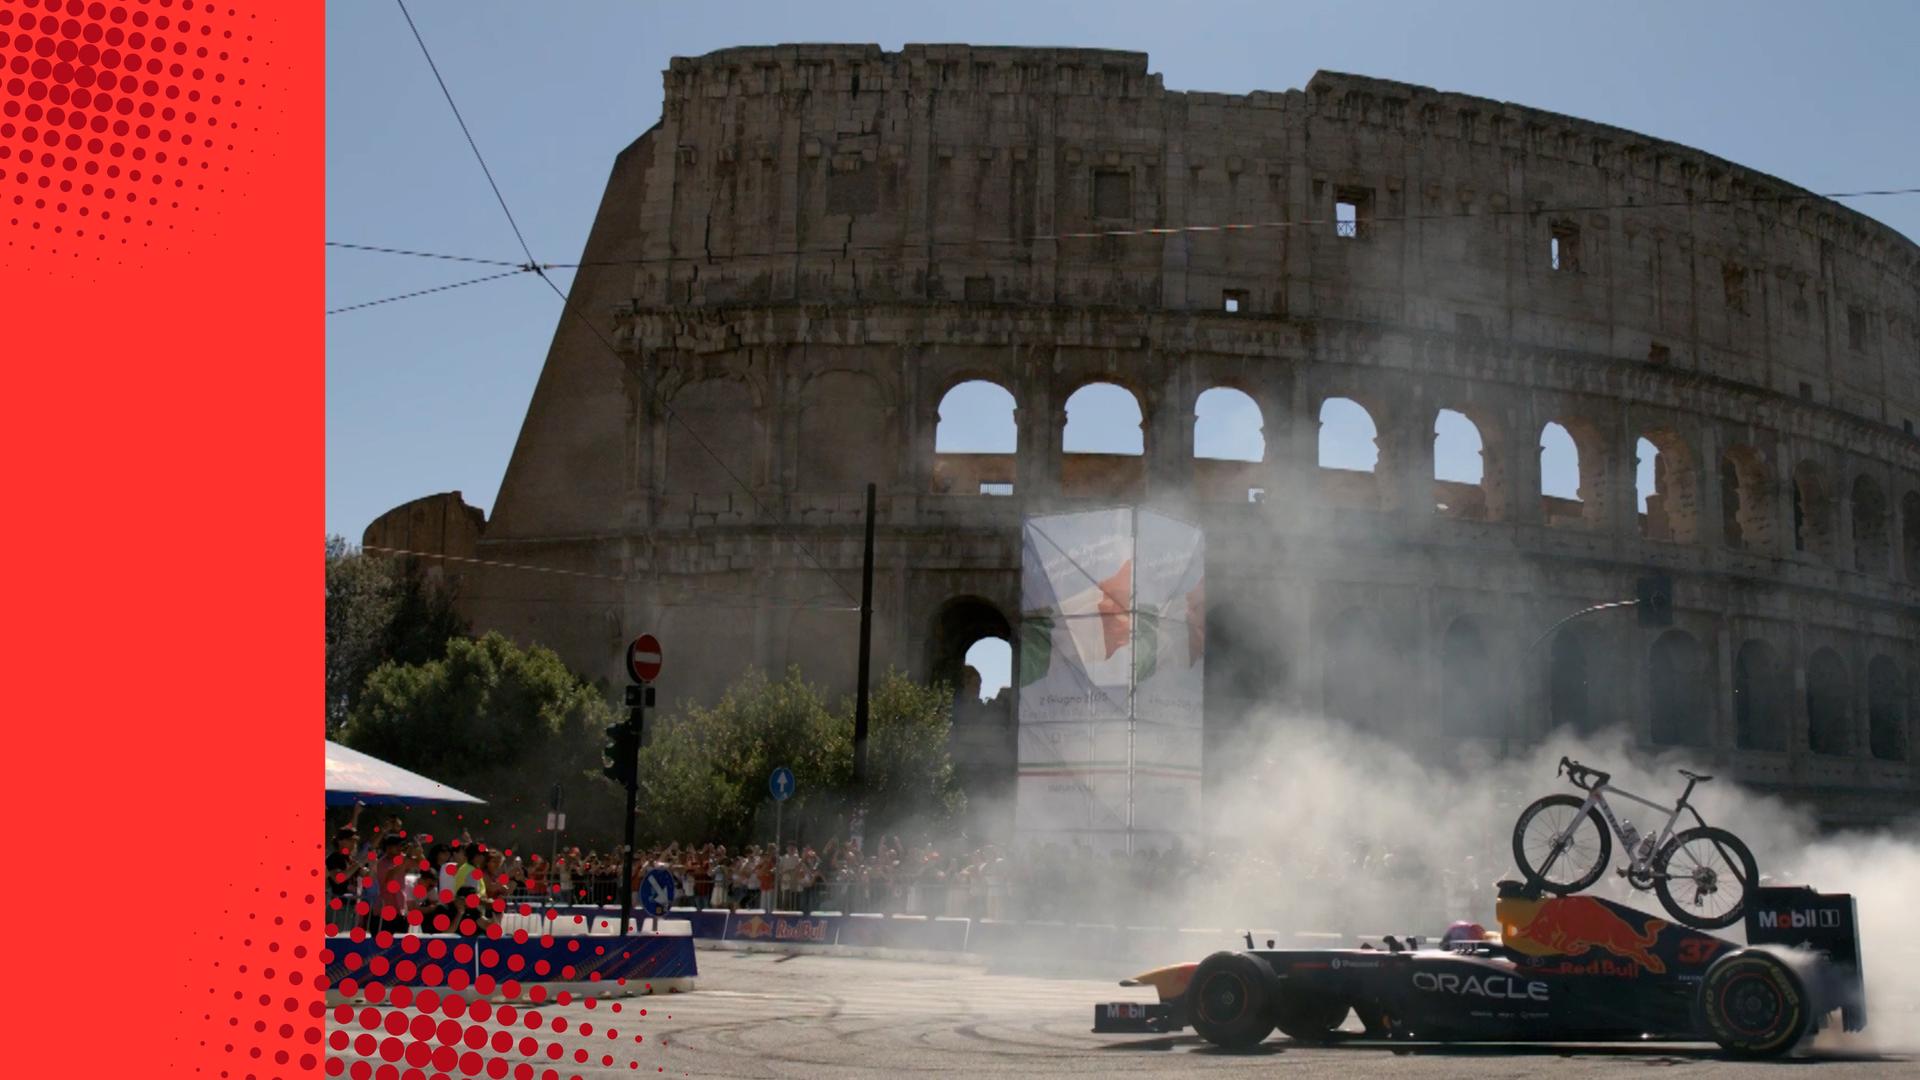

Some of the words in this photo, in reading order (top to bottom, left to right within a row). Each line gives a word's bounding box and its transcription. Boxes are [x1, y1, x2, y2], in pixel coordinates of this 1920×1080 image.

[776, 918, 802, 939] Red
[803, 920, 829, 941] Bull
[1759, 909, 1817, 929] Mobil
[1679, 938, 1721, 963] 37
[1560, 959, 1601, 976] Red
[1602, 959, 1640, 978] Bull
[1412, 971, 1550, 1001] ORACLE
[1106, 1004, 1146, 1020] Mobil
